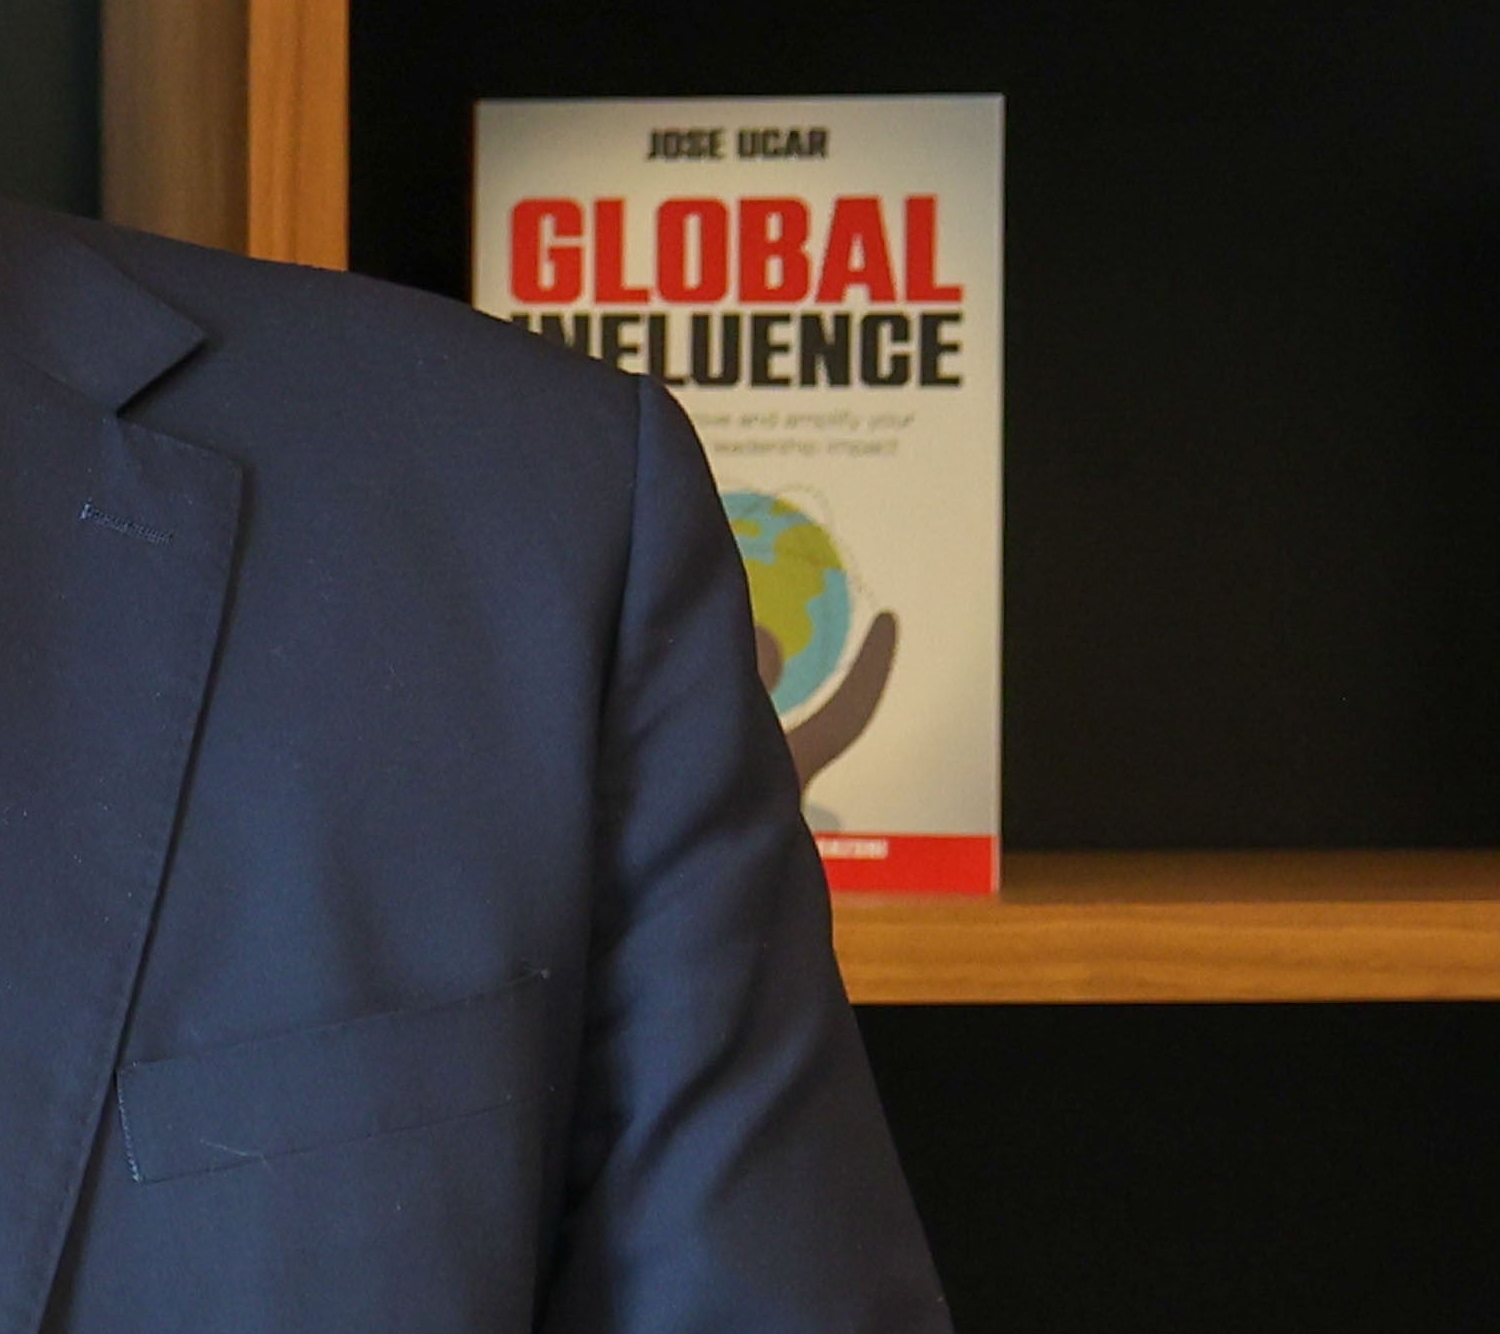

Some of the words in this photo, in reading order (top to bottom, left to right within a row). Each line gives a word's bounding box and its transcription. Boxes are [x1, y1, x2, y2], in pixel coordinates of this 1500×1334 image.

[646, 128, 725, 160] JOSE
[736, 128, 829, 159] UCAR
[510, 194, 964, 304] GLOBAL
[512, 312, 963, 387] FLUENCE
